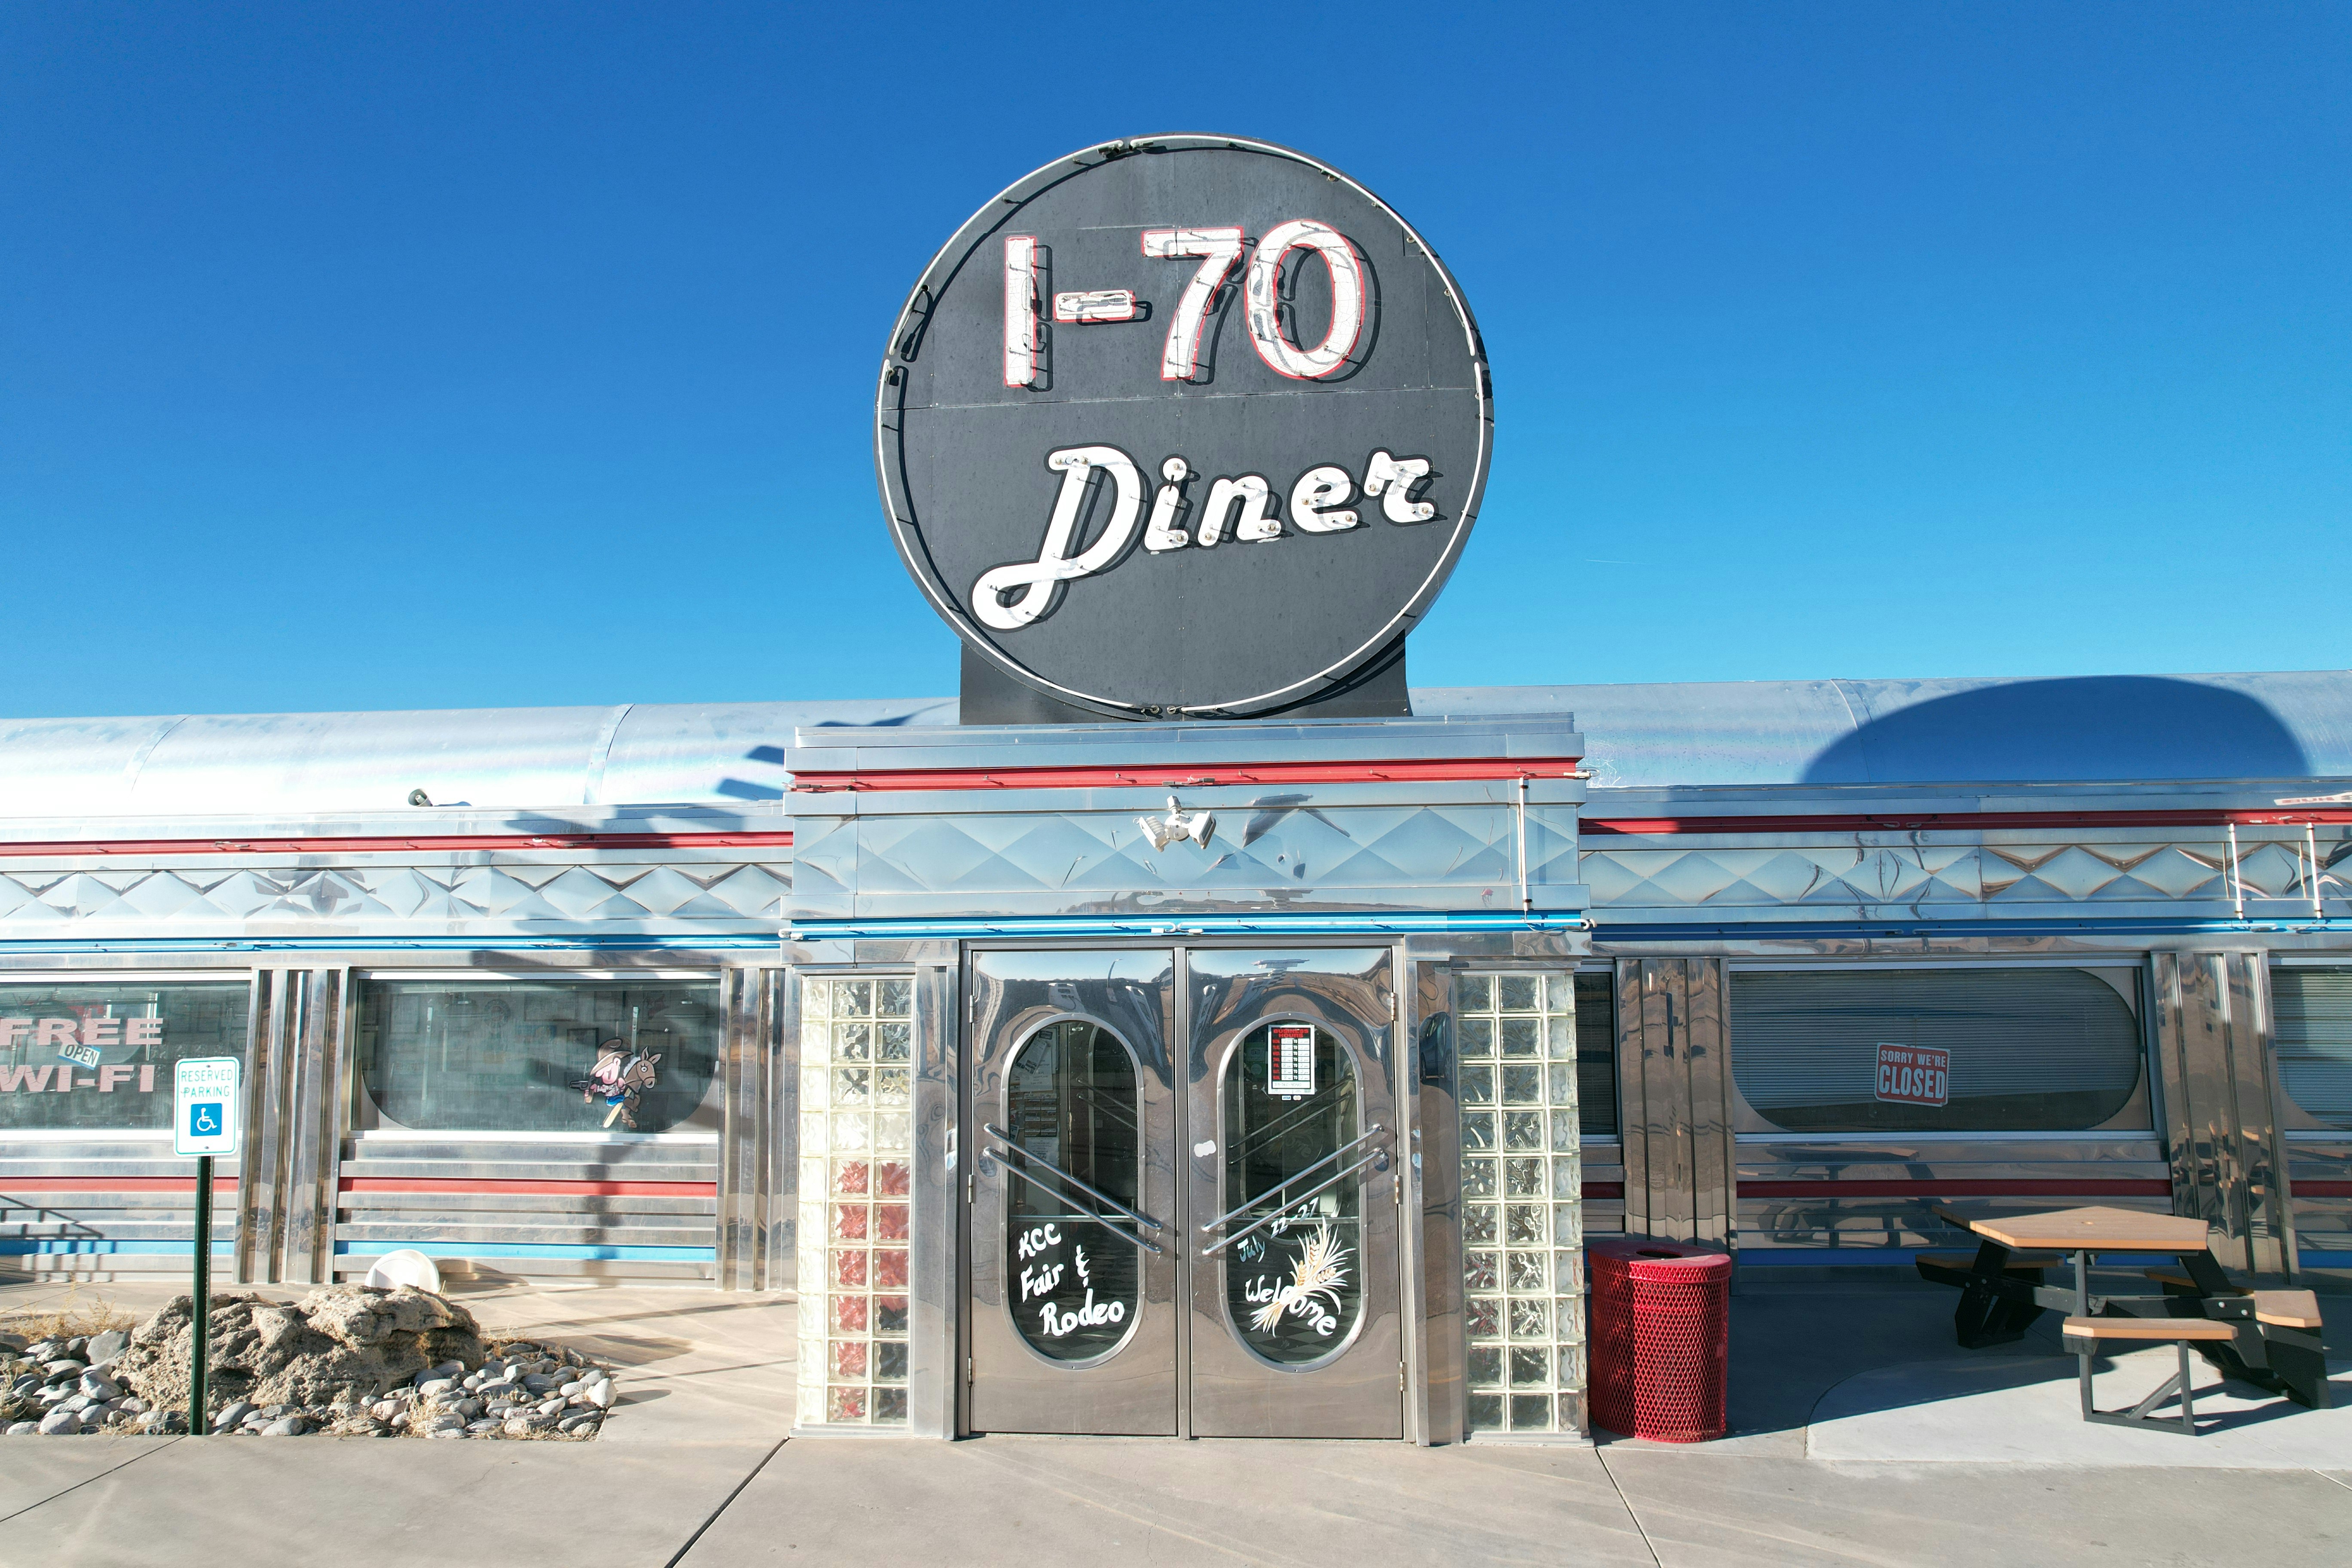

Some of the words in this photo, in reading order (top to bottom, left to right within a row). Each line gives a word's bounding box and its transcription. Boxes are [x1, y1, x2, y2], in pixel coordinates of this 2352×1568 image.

[1003, 219, 1366, 389] I-70
[971, 444, 1436, 630] Diner
[0, 1018, 163, 1045] FREE
[64, 1044, 98, 1066] OPEN
[1880, 1050, 1913, 1064] SORRY
[1917, 1054, 1946, 1067] WE'RE
[0, 1064, 155, 1092] WI-FI
[181, 1069, 233, 1082] RESERVED
[1879, 1065, 1945, 1099] CLOSED
[184, 1086, 230, 1098] PARKING
[1018, 1223, 1062, 1262] KCC
[1237, 1235, 1265, 1263] July
[1020, 1264, 1064, 1303] Fair
[1039, 1288, 1125, 1336] Rodeo
[1245, 1274, 1337, 1336] Welcome
